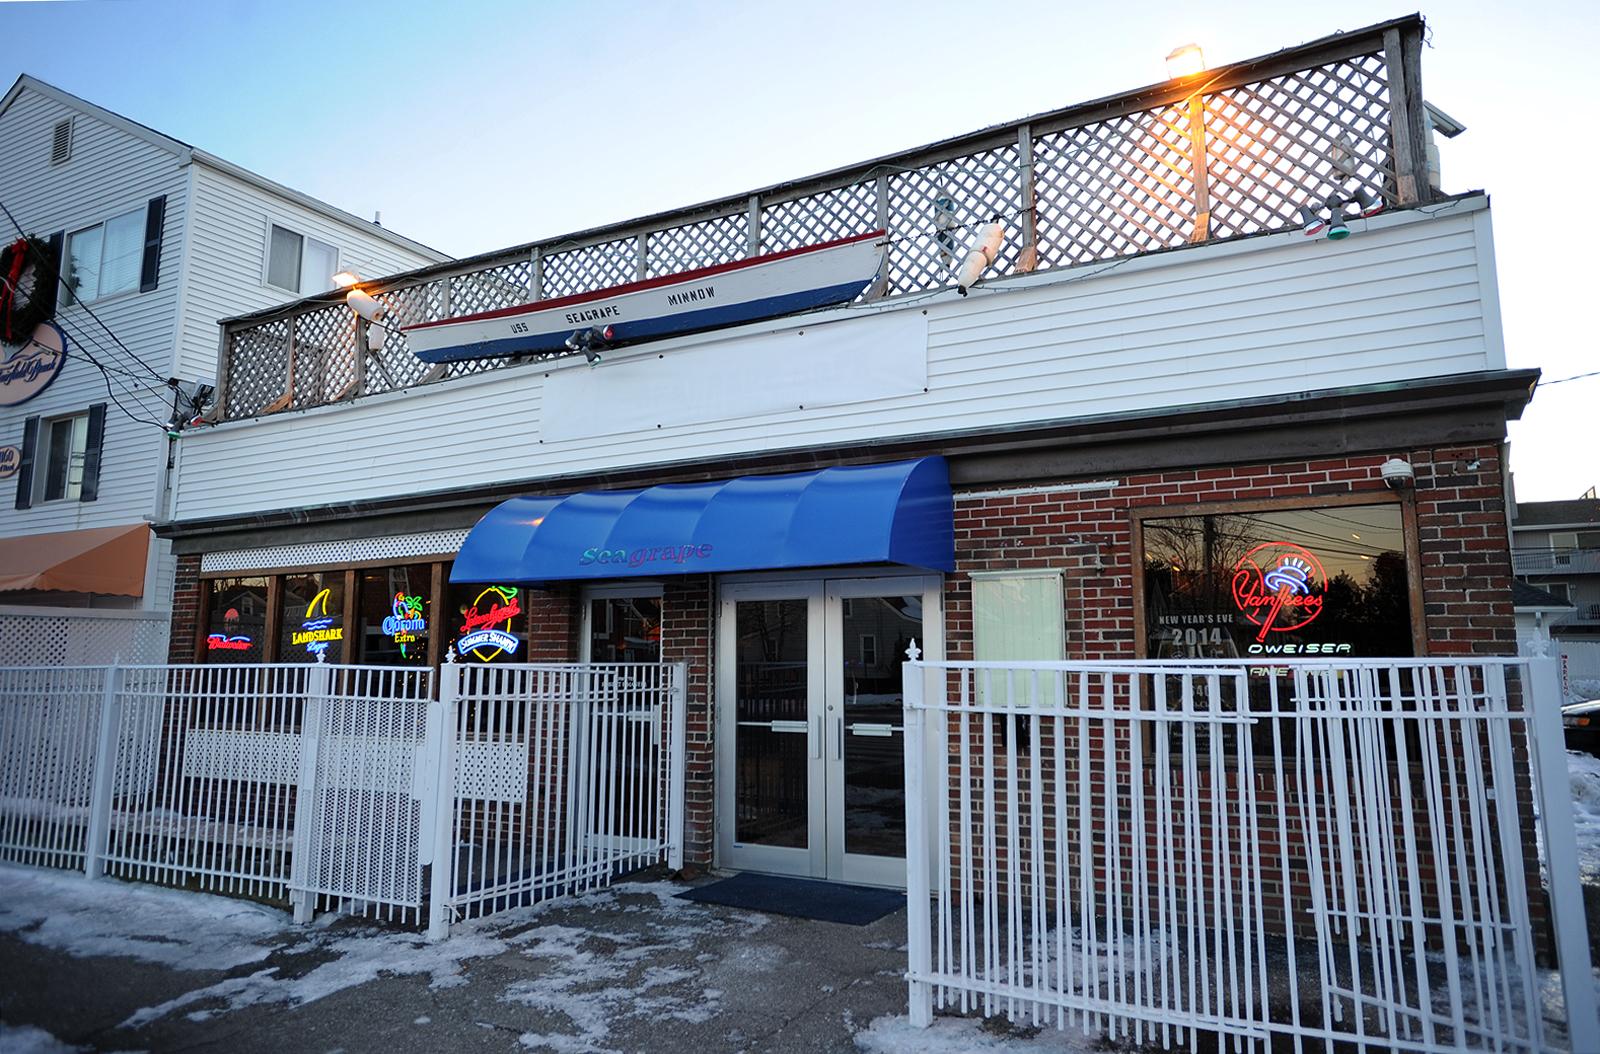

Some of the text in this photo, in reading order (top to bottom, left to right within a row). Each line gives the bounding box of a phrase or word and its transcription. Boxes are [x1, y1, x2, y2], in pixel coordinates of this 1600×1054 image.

[510, 286, 716, 334] USS SEAGRAPE MINNOW
[578, 543, 714, 568] Seagrape
[1232, 569, 1324, 609] Yankees
[382, 615, 426, 637] Corona
[1159, 614, 1234, 624] NEW YEAR'S EVE
[292, 627, 344, 645] LANDSHARK
[394, 632, 416, 643] Extra
[1171, 627, 1222, 646] 2014
